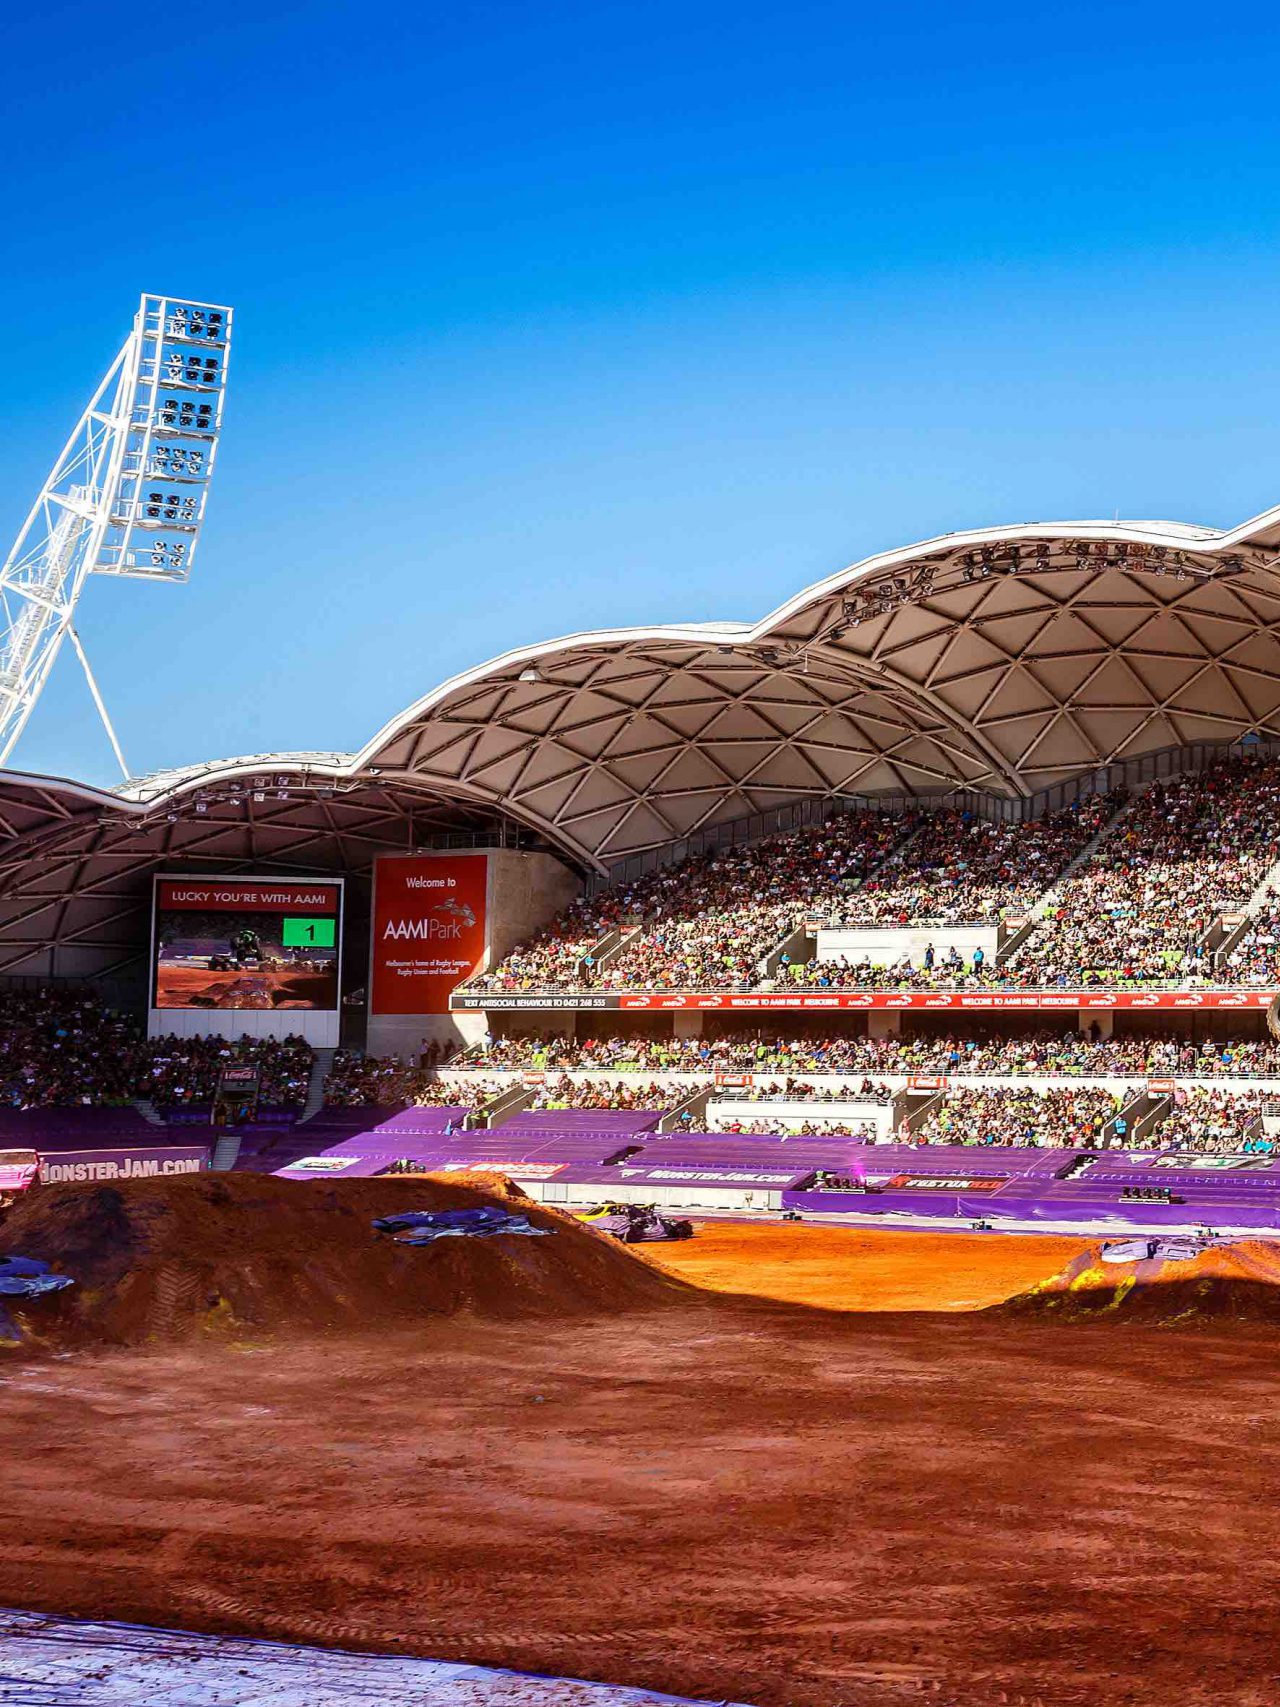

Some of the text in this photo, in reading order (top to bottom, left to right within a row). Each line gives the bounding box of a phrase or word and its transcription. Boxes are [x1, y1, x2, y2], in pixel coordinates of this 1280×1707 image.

[406, 877, 456, 889] Welcome to
[172, 891, 326, 905] LUCKY YOU'RE WITH AAMI
[305, 924, 315, 942] 1
[436, 960, 452, 969] Rugby
[397, 968, 412, 977] Rugby
[439, 967, 459, 975] Football
[464, 999, 478, 1007] TEXT
[517, 999, 552, 1007] BEHAVIOUR
[554, 999, 562, 1007] TO
[563, 999, 579, 1007] 0421
[580, 999, 592, 1007] 268
[593, 999, 606, 1007] 555
